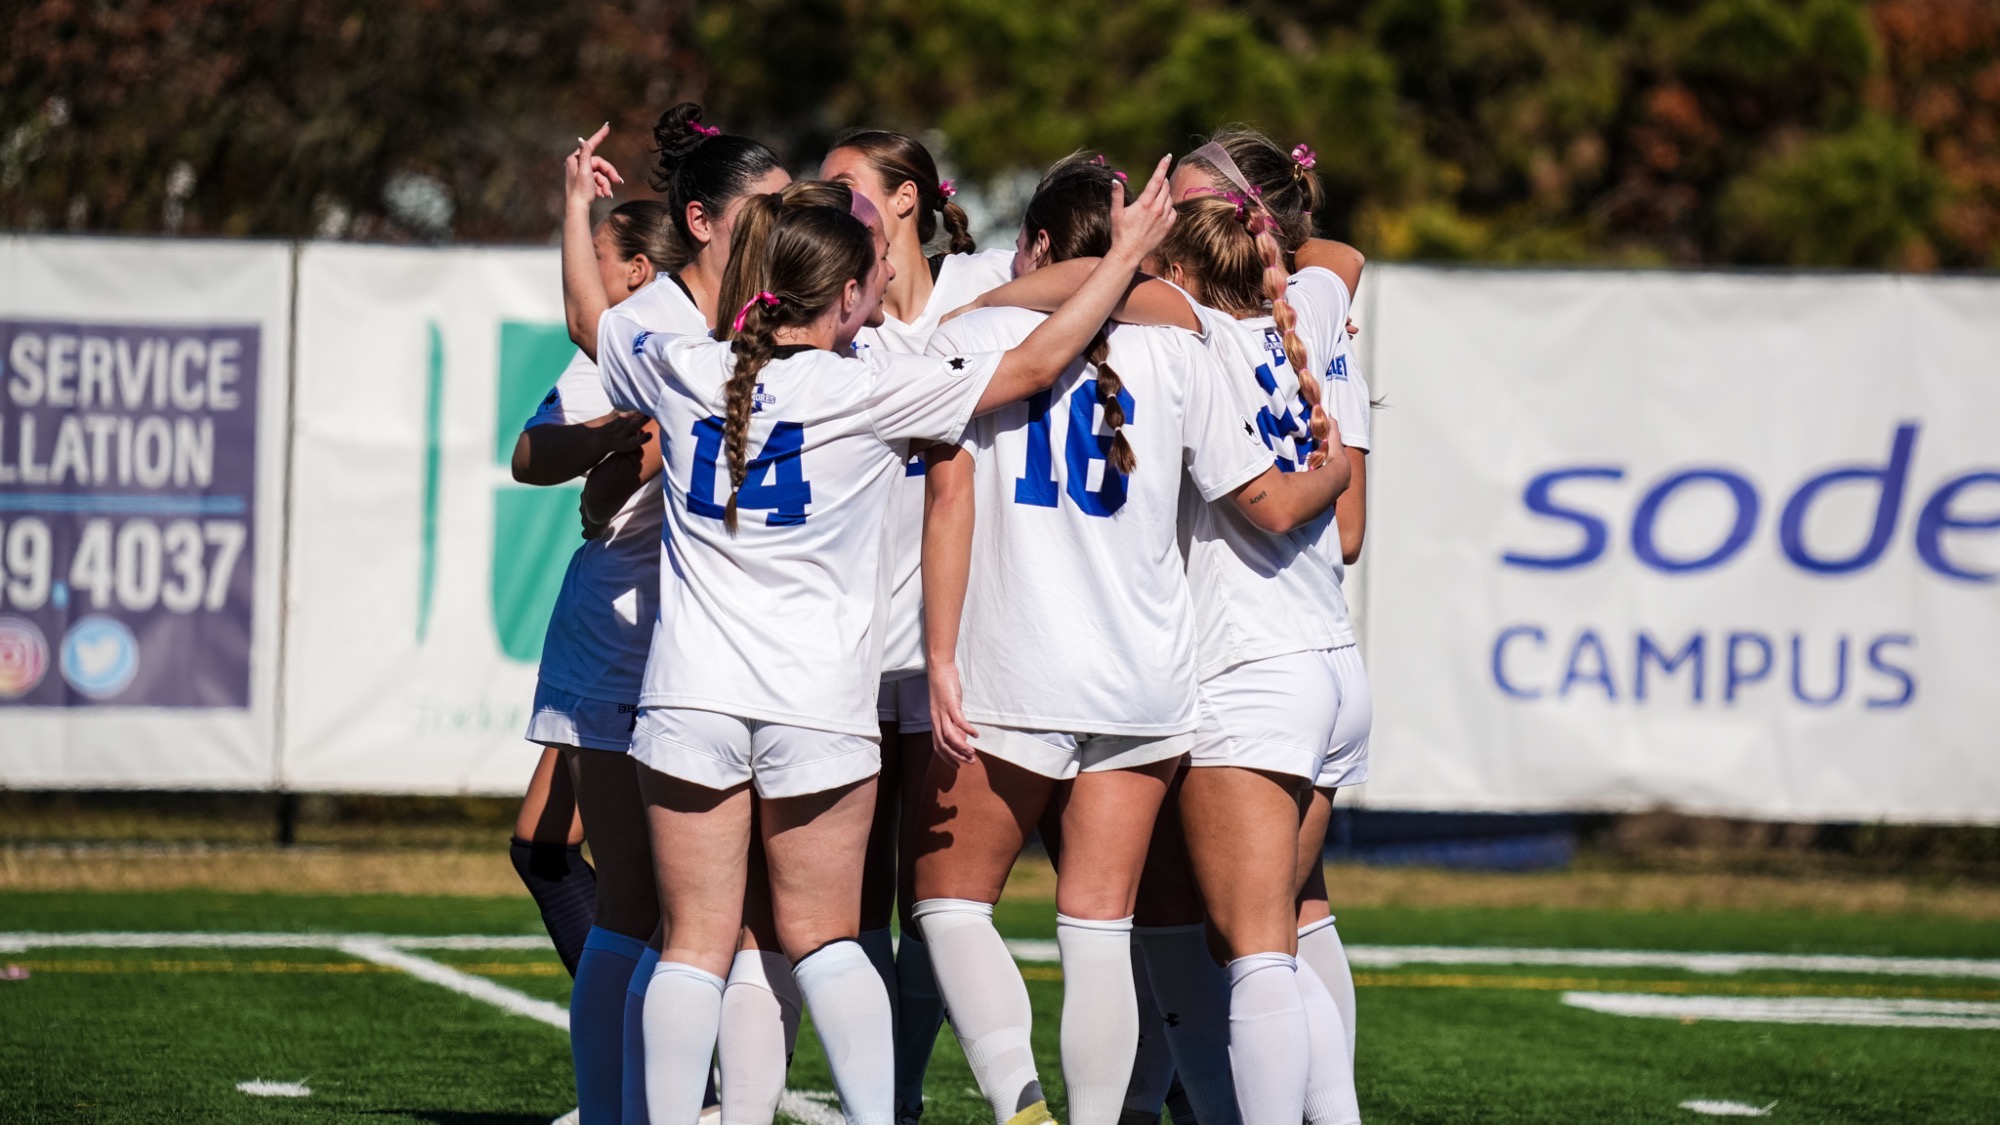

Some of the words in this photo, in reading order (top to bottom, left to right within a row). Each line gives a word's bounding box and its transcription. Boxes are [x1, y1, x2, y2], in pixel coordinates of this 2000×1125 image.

[8, 333, 241, 411] SERVICE
[686, 414, 812, 527] 14
[1014, 379, 1135, 518] 16
[1500, 418, 2000, 584] sode
[0, 516, 247, 613] 9.4037
[1491, 624, 1918, 711] CAMPUS
